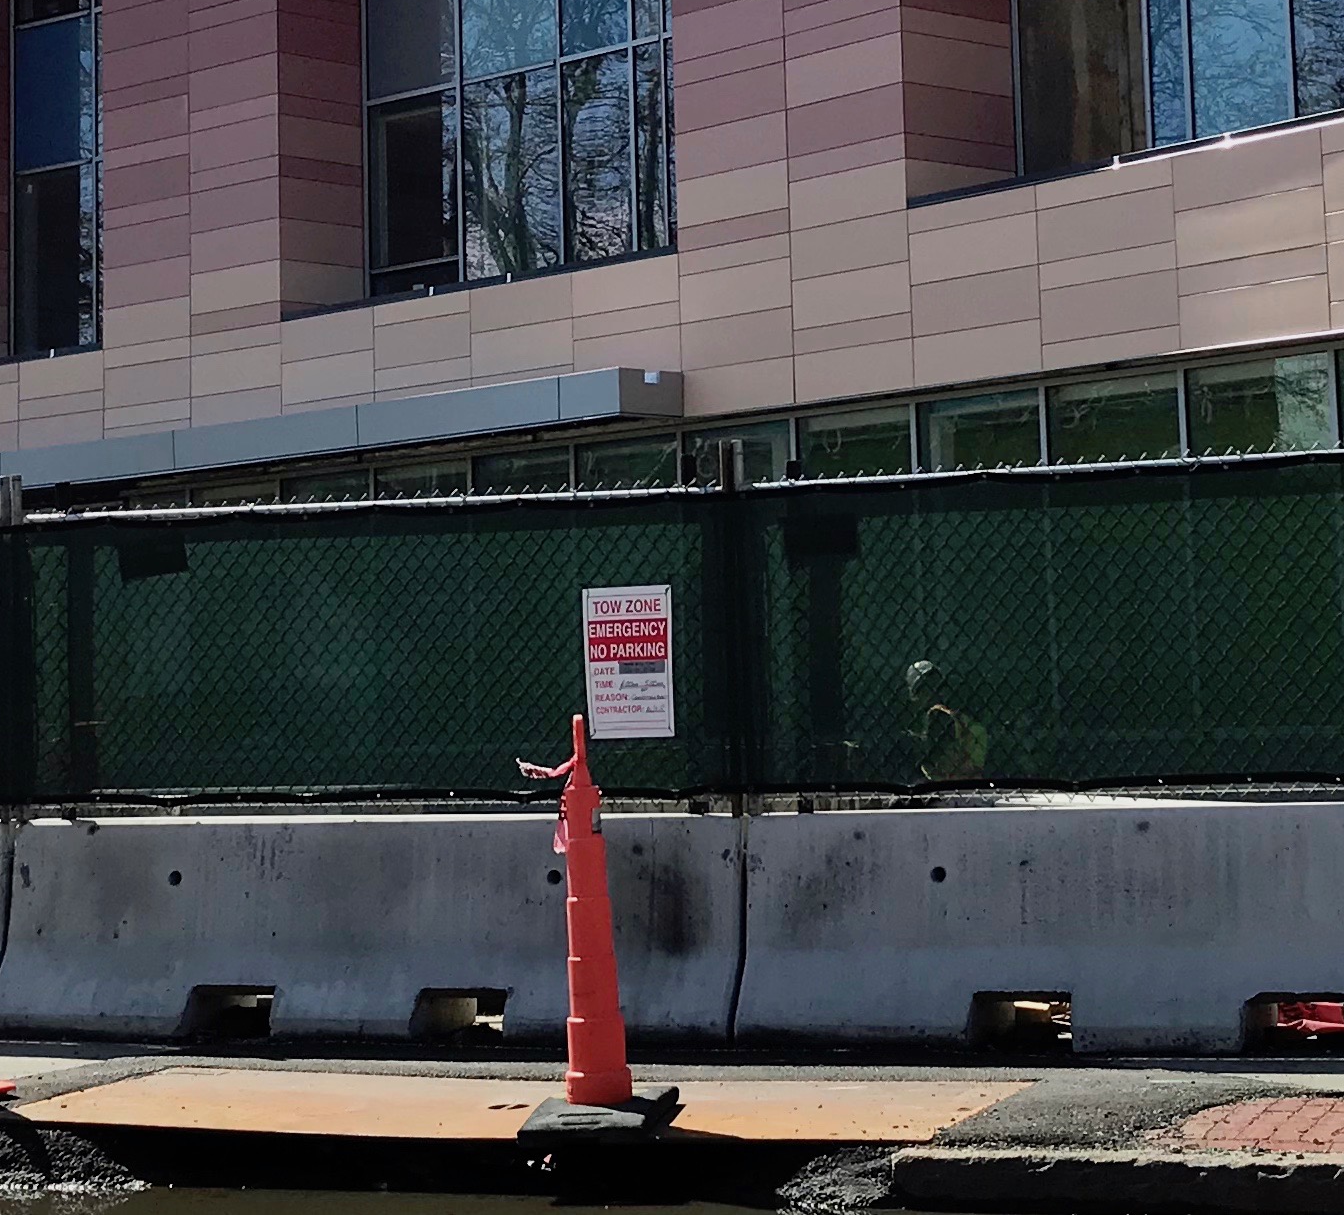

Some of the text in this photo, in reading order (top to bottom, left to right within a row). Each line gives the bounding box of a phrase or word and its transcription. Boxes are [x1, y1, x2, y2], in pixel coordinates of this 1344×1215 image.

[593, 598, 662, 615] TOW ZONE
[589, 622, 666, 638] EMERGENCY
[590, 642, 665, 659] NO PARKING
